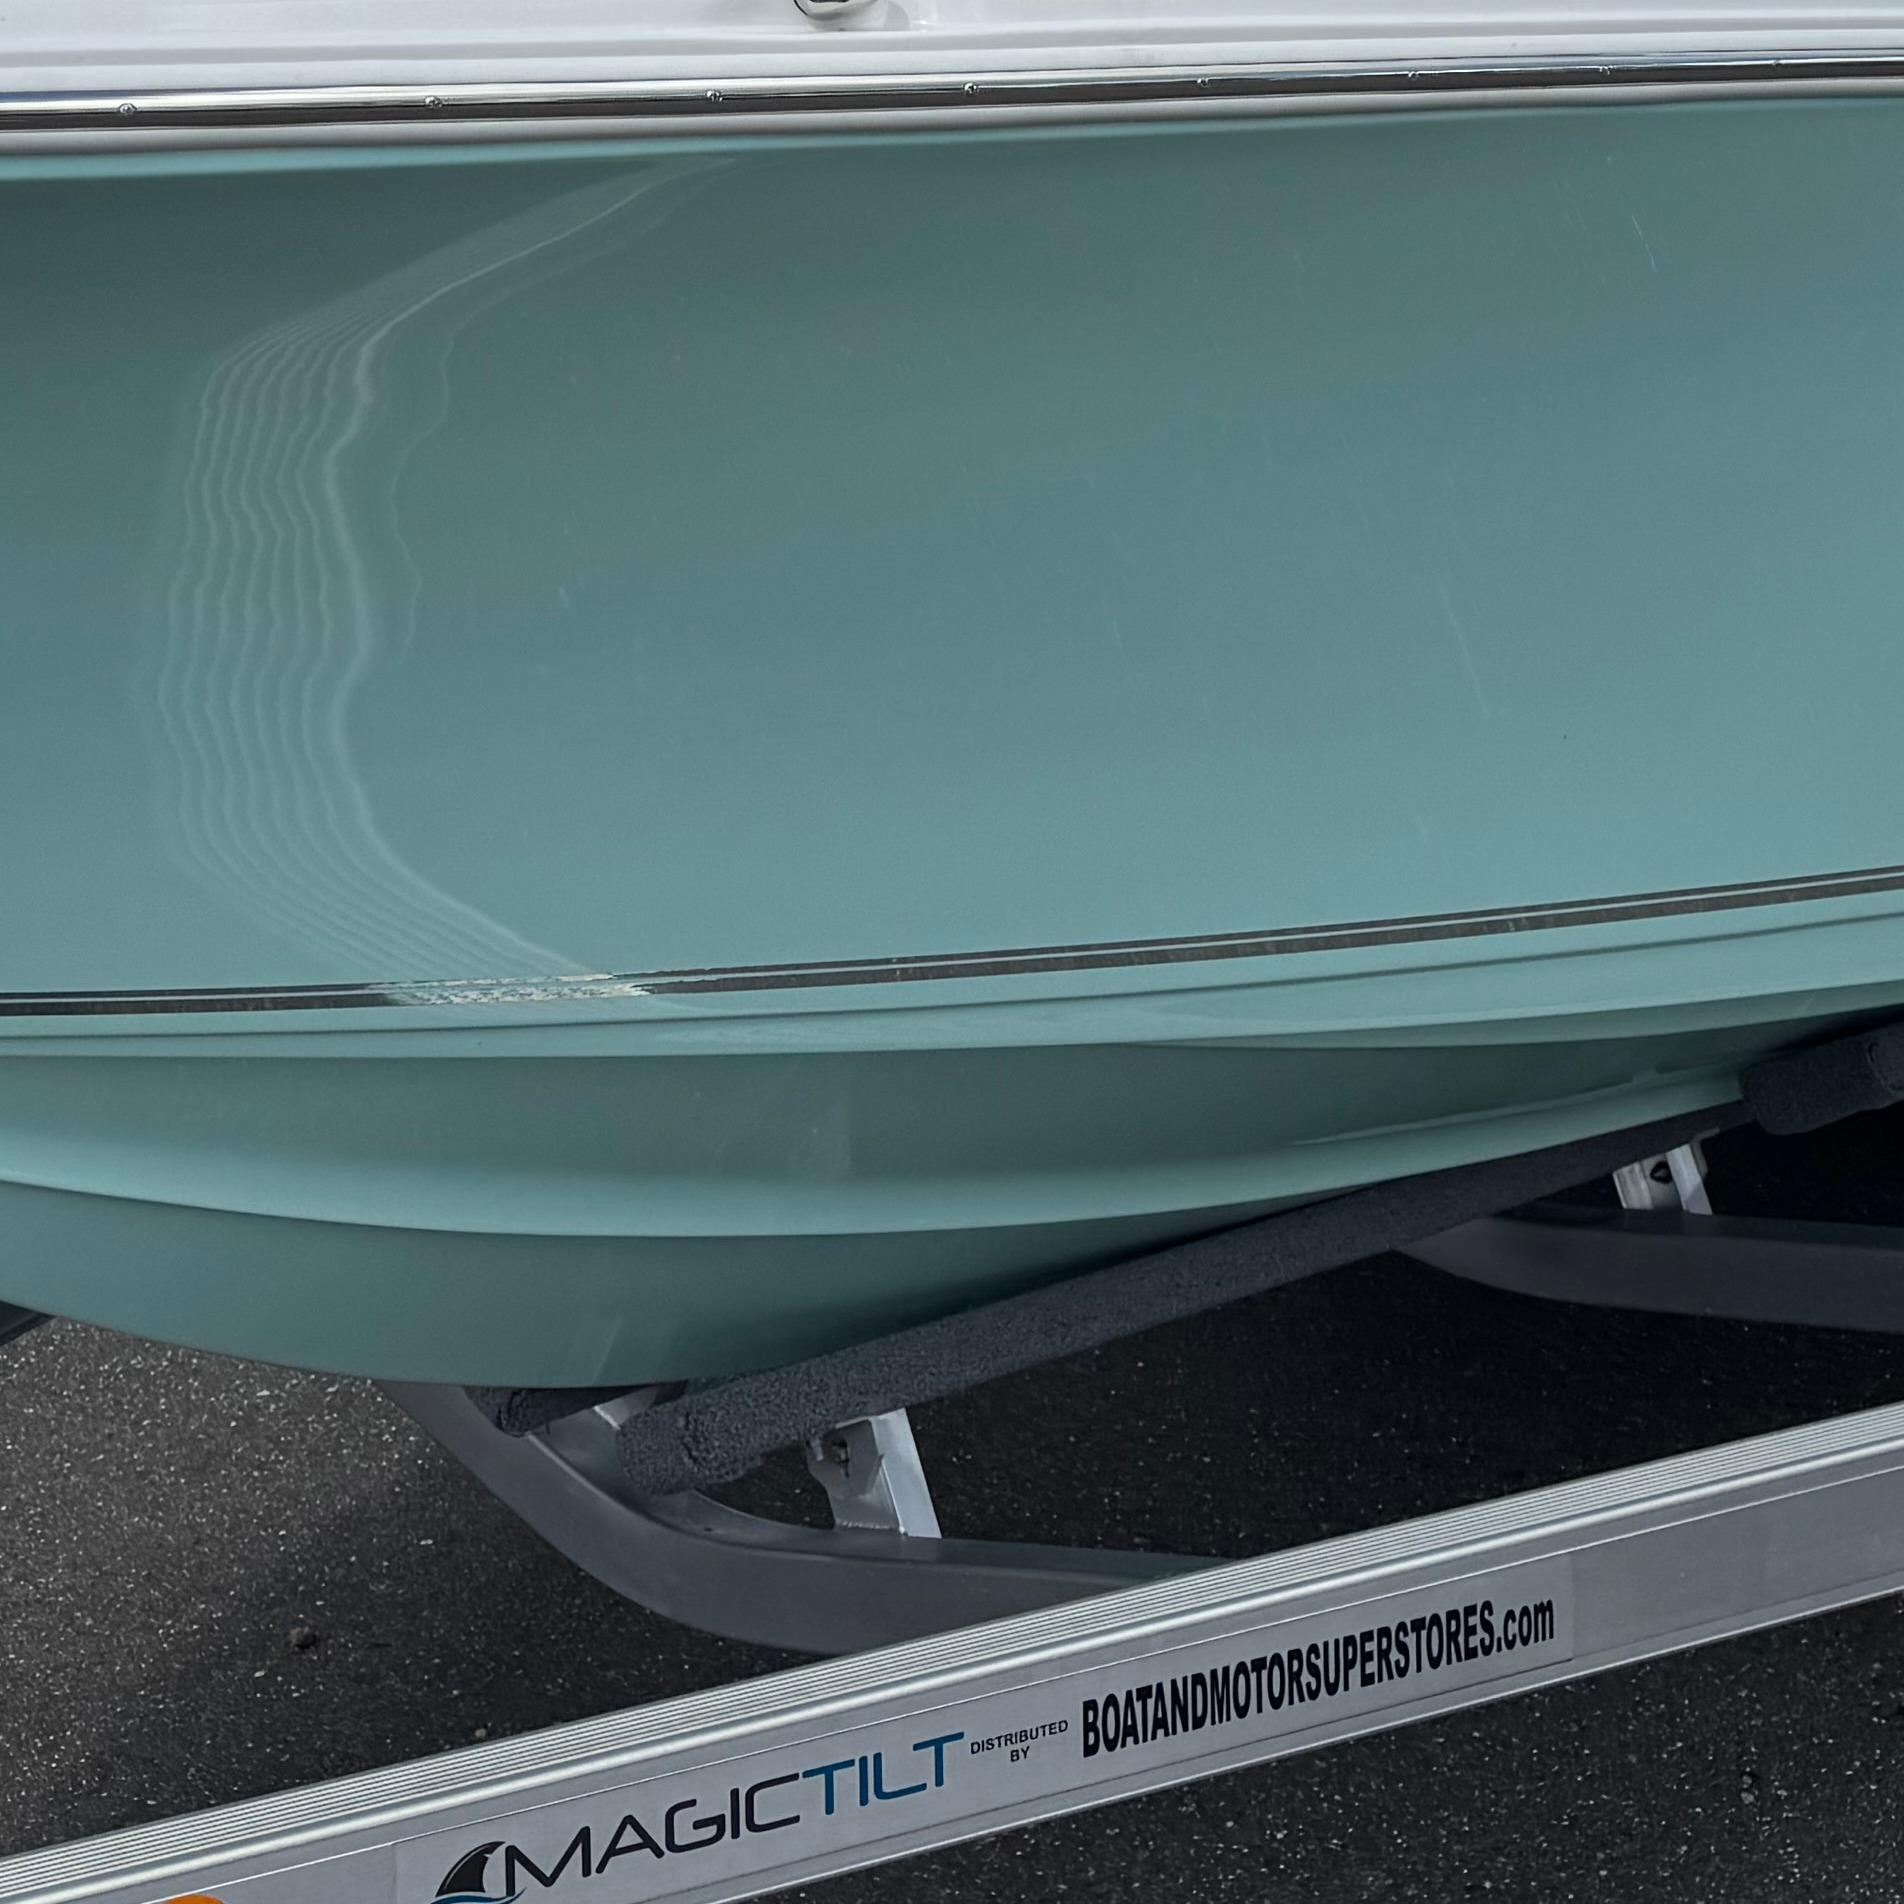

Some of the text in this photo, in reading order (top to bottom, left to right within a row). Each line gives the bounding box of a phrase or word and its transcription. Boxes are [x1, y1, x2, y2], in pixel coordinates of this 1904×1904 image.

[969, 1719, 1069, 1755] DISTRIBUTED
[1082, 1598, 1555, 1758] BOATANDMOTORSUPERSTORES.com
[1009, 1745, 1030, 1763] BY
